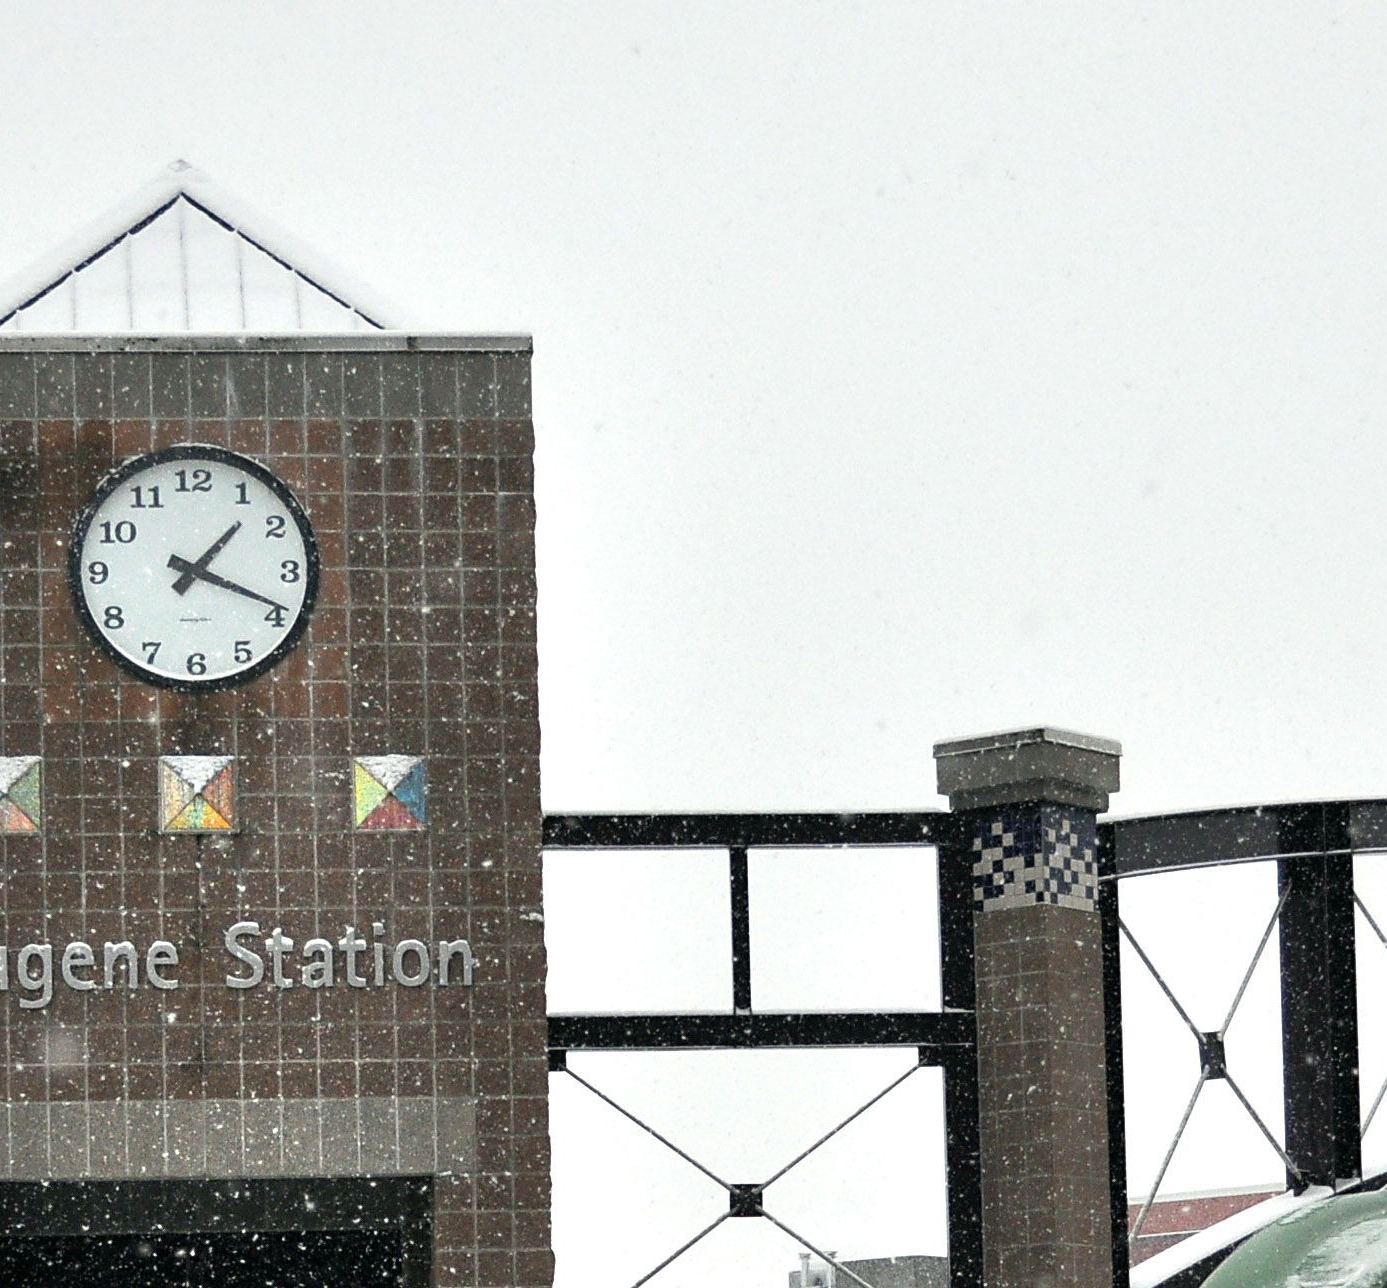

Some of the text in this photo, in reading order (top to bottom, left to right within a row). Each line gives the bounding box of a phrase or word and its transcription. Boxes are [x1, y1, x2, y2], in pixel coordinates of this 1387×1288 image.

[174, 469, 213, 493] 12
[129, 485, 165, 509] 11
[234, 482, 251, 505] 1
[99, 520, 137, 544] 10
[265, 515, 286, 539] 2
[88, 561, 109, 585] 9
[280, 559, 300, 584] 3
[103, 605, 125, 630] 8
[264, 602, 286, 628] 4
[142, 641, 162, 665] 7
[186, 652, 207, 676] 6
[233, 640, 253, 664] 5
[224, 920, 475, 990] Station
